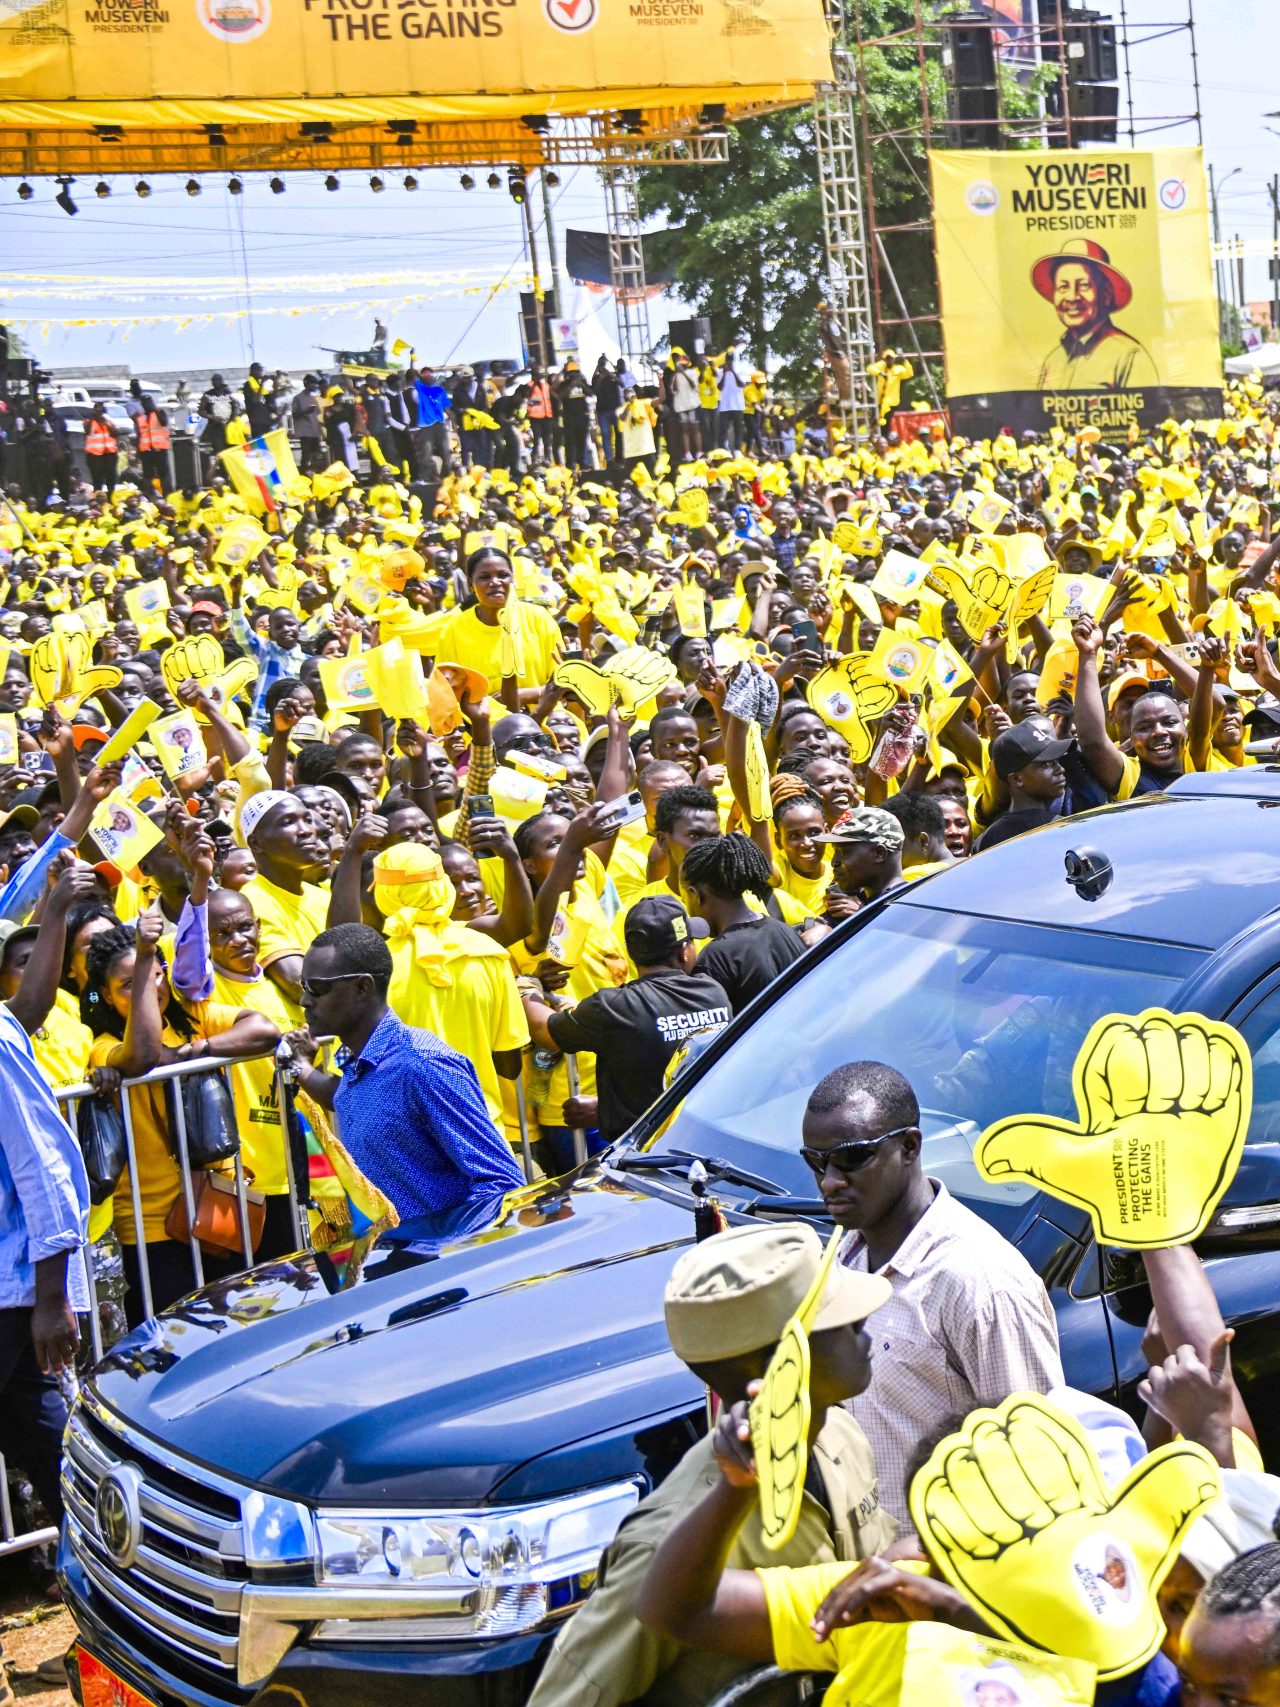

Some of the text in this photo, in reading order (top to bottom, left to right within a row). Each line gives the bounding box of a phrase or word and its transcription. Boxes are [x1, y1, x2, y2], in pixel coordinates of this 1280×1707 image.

[85, 10, 170, 23] MUSEVENI
[629, 4, 704, 17] MUSEVENI
[93, 25, 150, 33] PRESIDENT
[322, 11, 503, 41] THE GAINS
[637, 18, 687, 26] PRESIDENT
[1025, 163, 1130, 187] YOWERI
[1012, 187, 1147, 213] MUSEVENI
[1026, 215, 1116, 232] PRESIDENT
[1042, 393, 1145, 413] PROTECTING
[1052, 410, 1138, 428] THE GAINS
[656, 1006, 729, 1031] SECURITY
[1113, 1154, 1129, 1224] PRESIDENT
[1129, 1137, 1141, 1222] PROTECTING
[1140, 1143, 1154, 1214] THE GAINS
